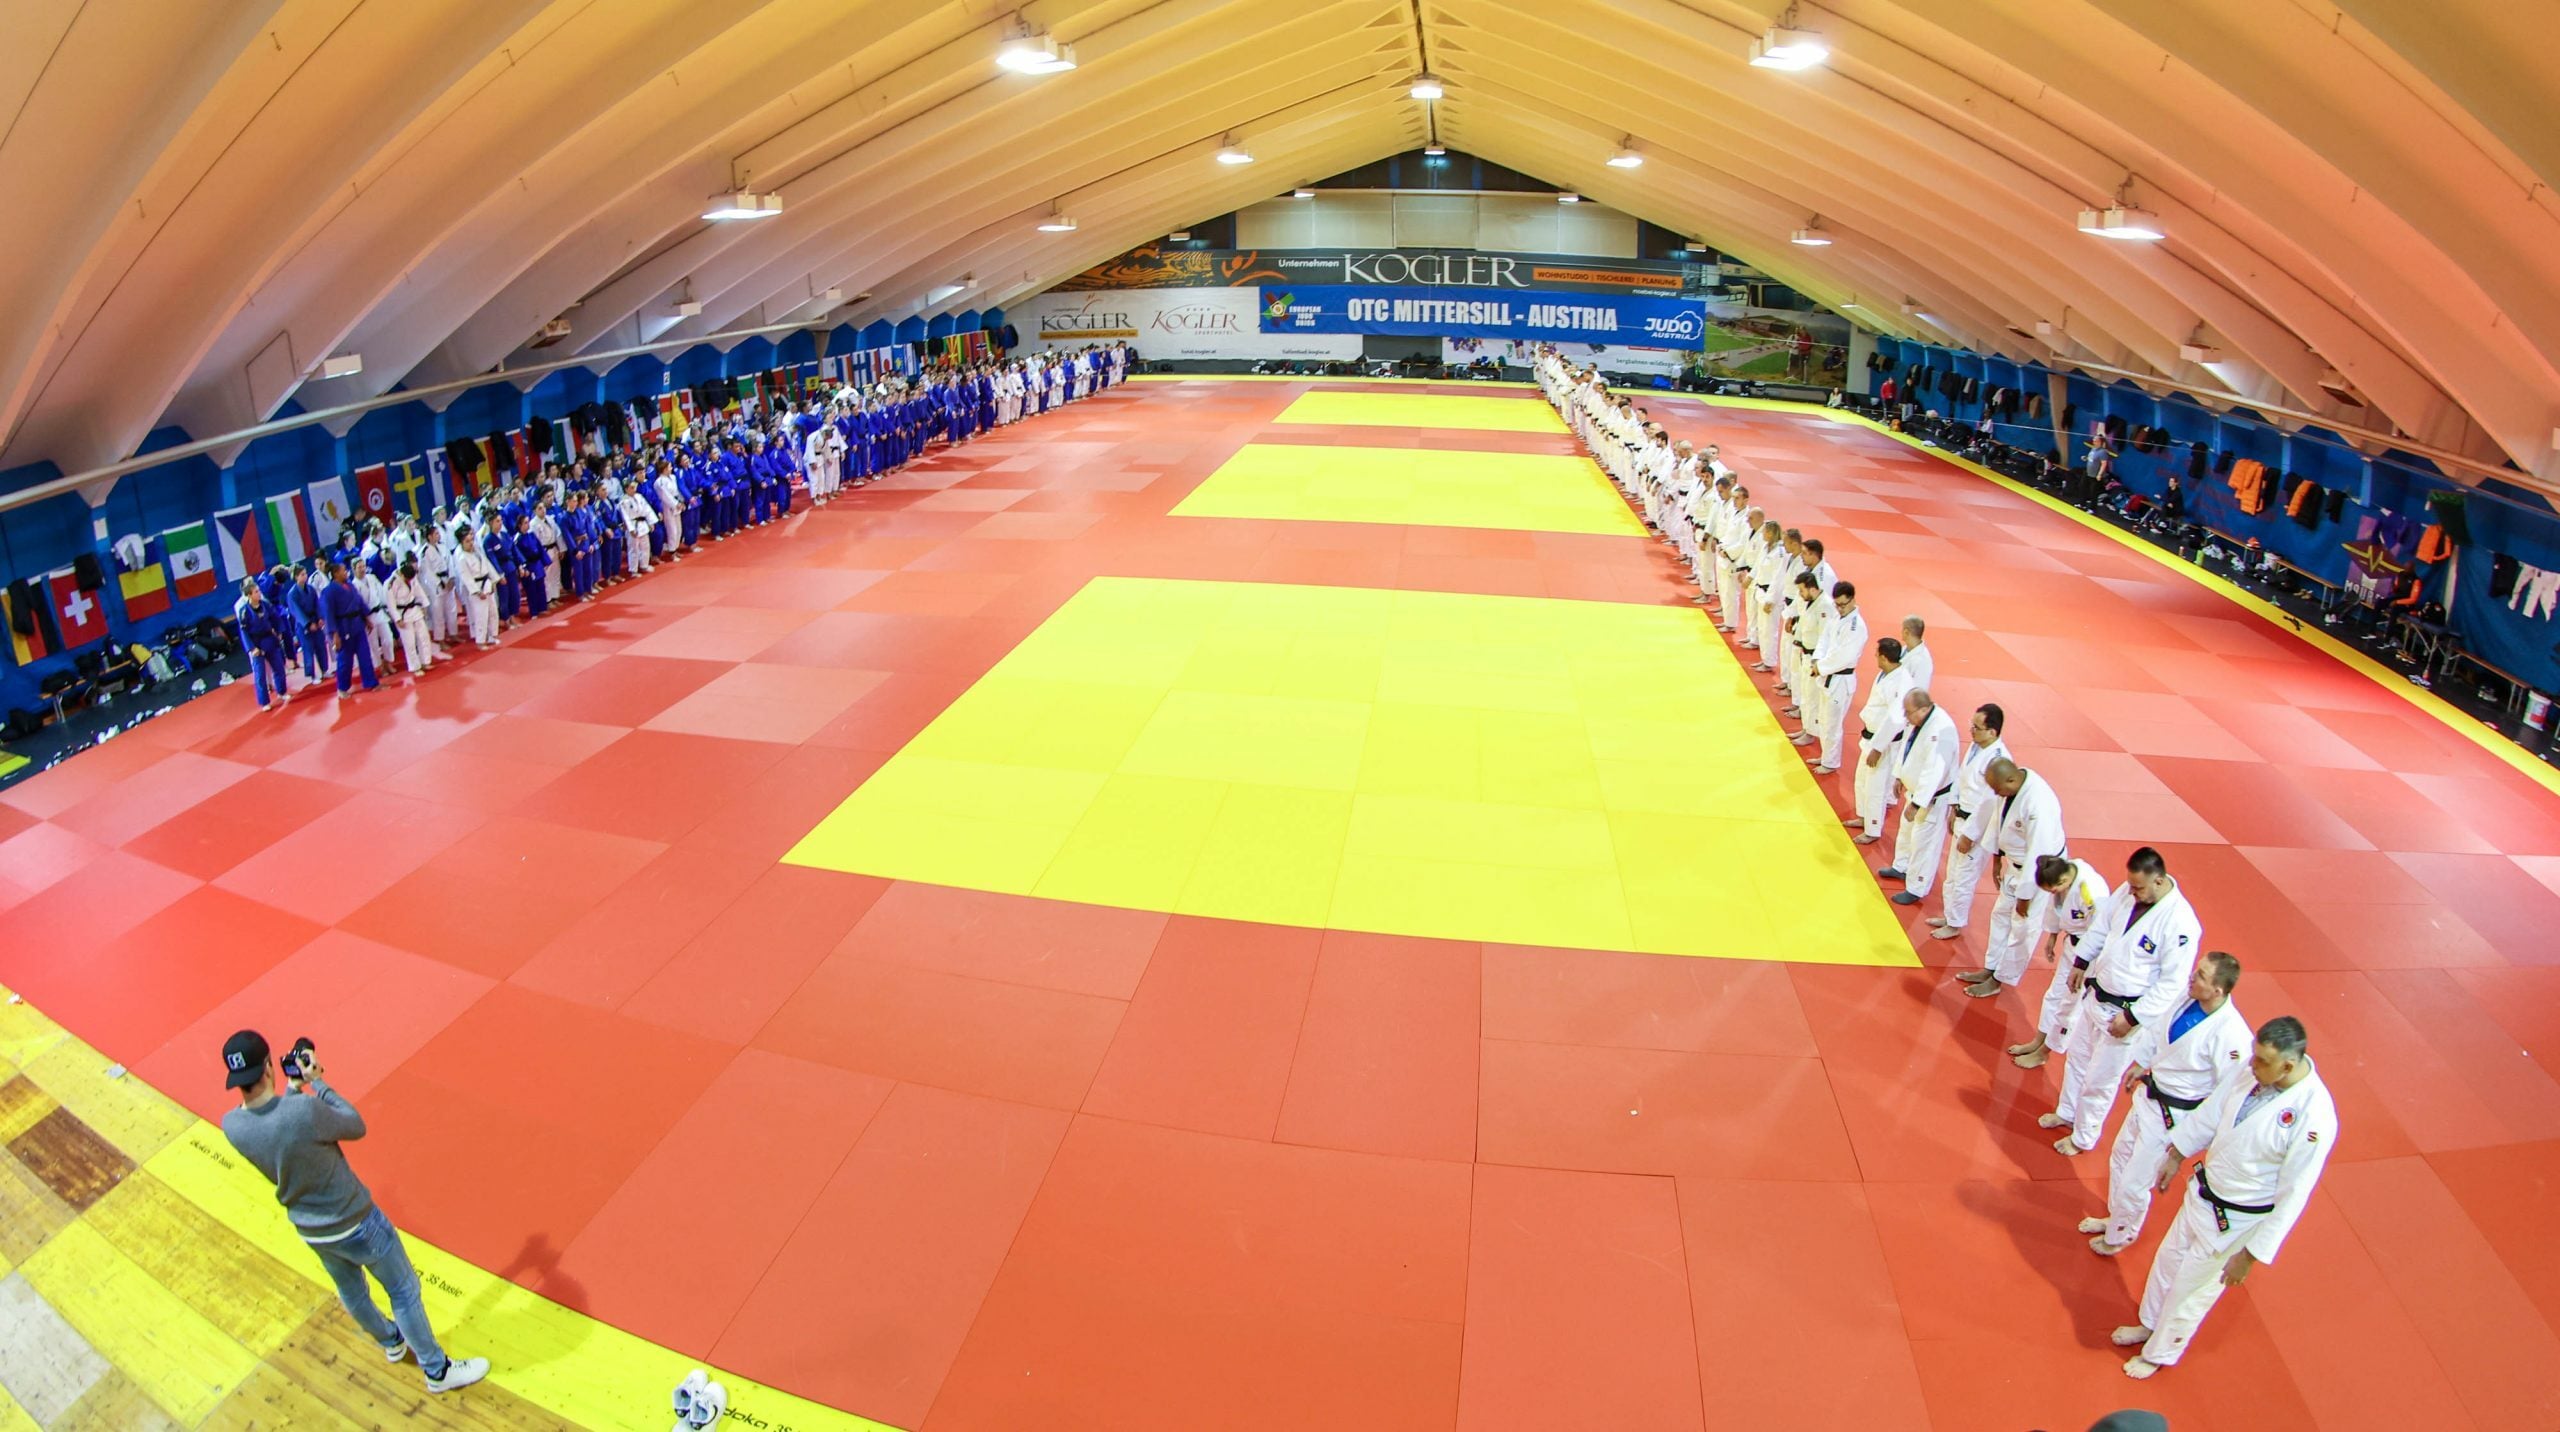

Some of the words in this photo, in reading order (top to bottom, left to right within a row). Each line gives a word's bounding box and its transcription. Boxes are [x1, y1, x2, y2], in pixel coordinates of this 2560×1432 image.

[1278, 258, 1340, 268] Unternehmen
[1343, 253, 1530, 288] KOGLER
[1537, 271, 1589, 281] WOHNSTUDIO
[1641, 277, 1677, 287] PLANUNG
[1289, 305, 1322, 313] EUROPEAN
[1347, 298, 1389, 321] OTC
[1393, 299, 1512, 326] MITTERSILL
[1527, 304, 1618, 331] AUSTRIA
[1041, 312, 1135, 331] KOGLER
[1150, 310, 1247, 334] KOGLER
[1643, 317, 1694, 334] JUDO
[1650, 332, 1692, 340] AUSTRIA
[439, 1280, 463, 1298] basic
[723, 1407, 769, 1430] doka
